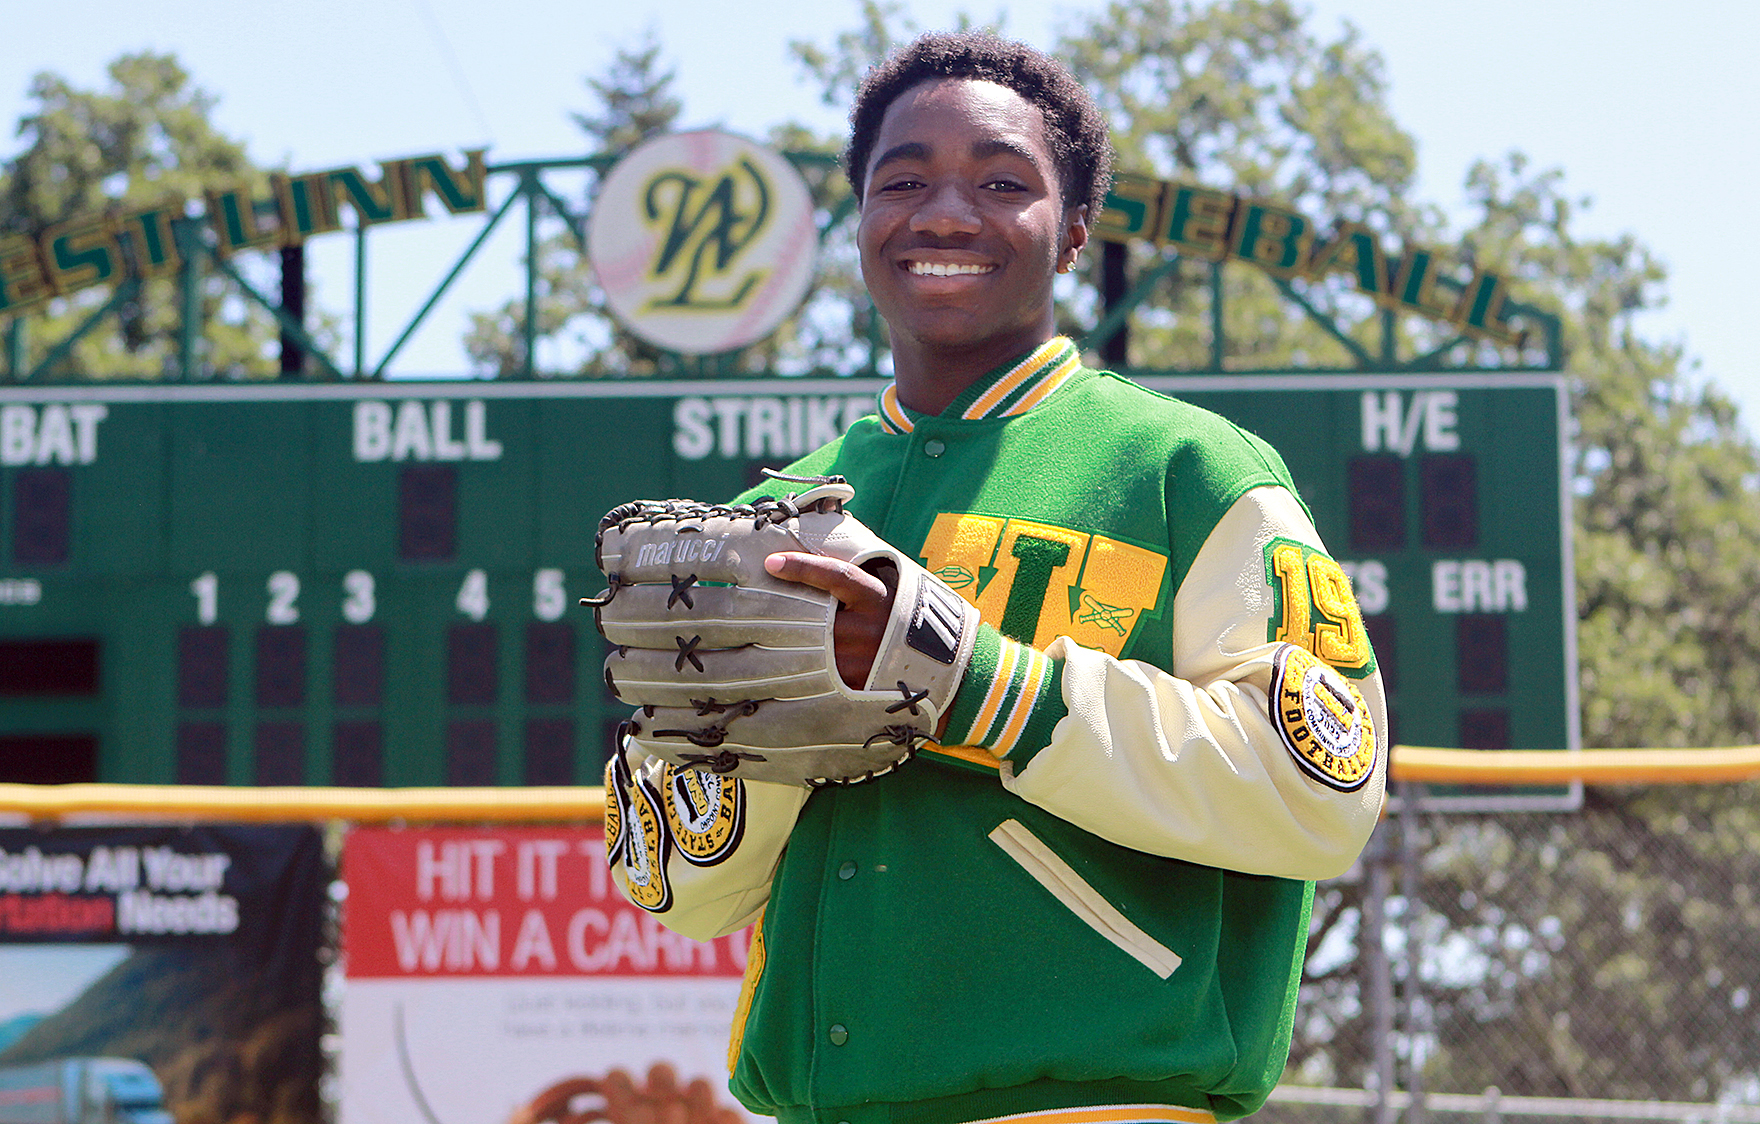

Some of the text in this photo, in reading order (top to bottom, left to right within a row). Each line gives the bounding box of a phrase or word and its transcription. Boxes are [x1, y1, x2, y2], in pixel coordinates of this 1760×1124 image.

[206, 148, 487, 260] LINN
[2, 403, 108, 466] BAT
[352, 400, 503, 462] BALL
[1360, 391, 1461, 455] H/E
[635, 532, 730, 568] marucci
[191, 572, 218, 625] 1
[266, 571, 300, 625] 2
[342, 570, 376, 624] 3
[456, 569, 490, 622] 4
[534, 568, 567, 622] 5
[1431, 559, 1528, 613] ERR
[1264, 538, 1376, 678] 19
[1284, 688, 1366, 775] FOOTBALL
[416, 840, 506, 900] HIT
[517, 840, 571, 900] IT
[390, 909, 500, 972] WIN
[510, 909, 557, 971] A
